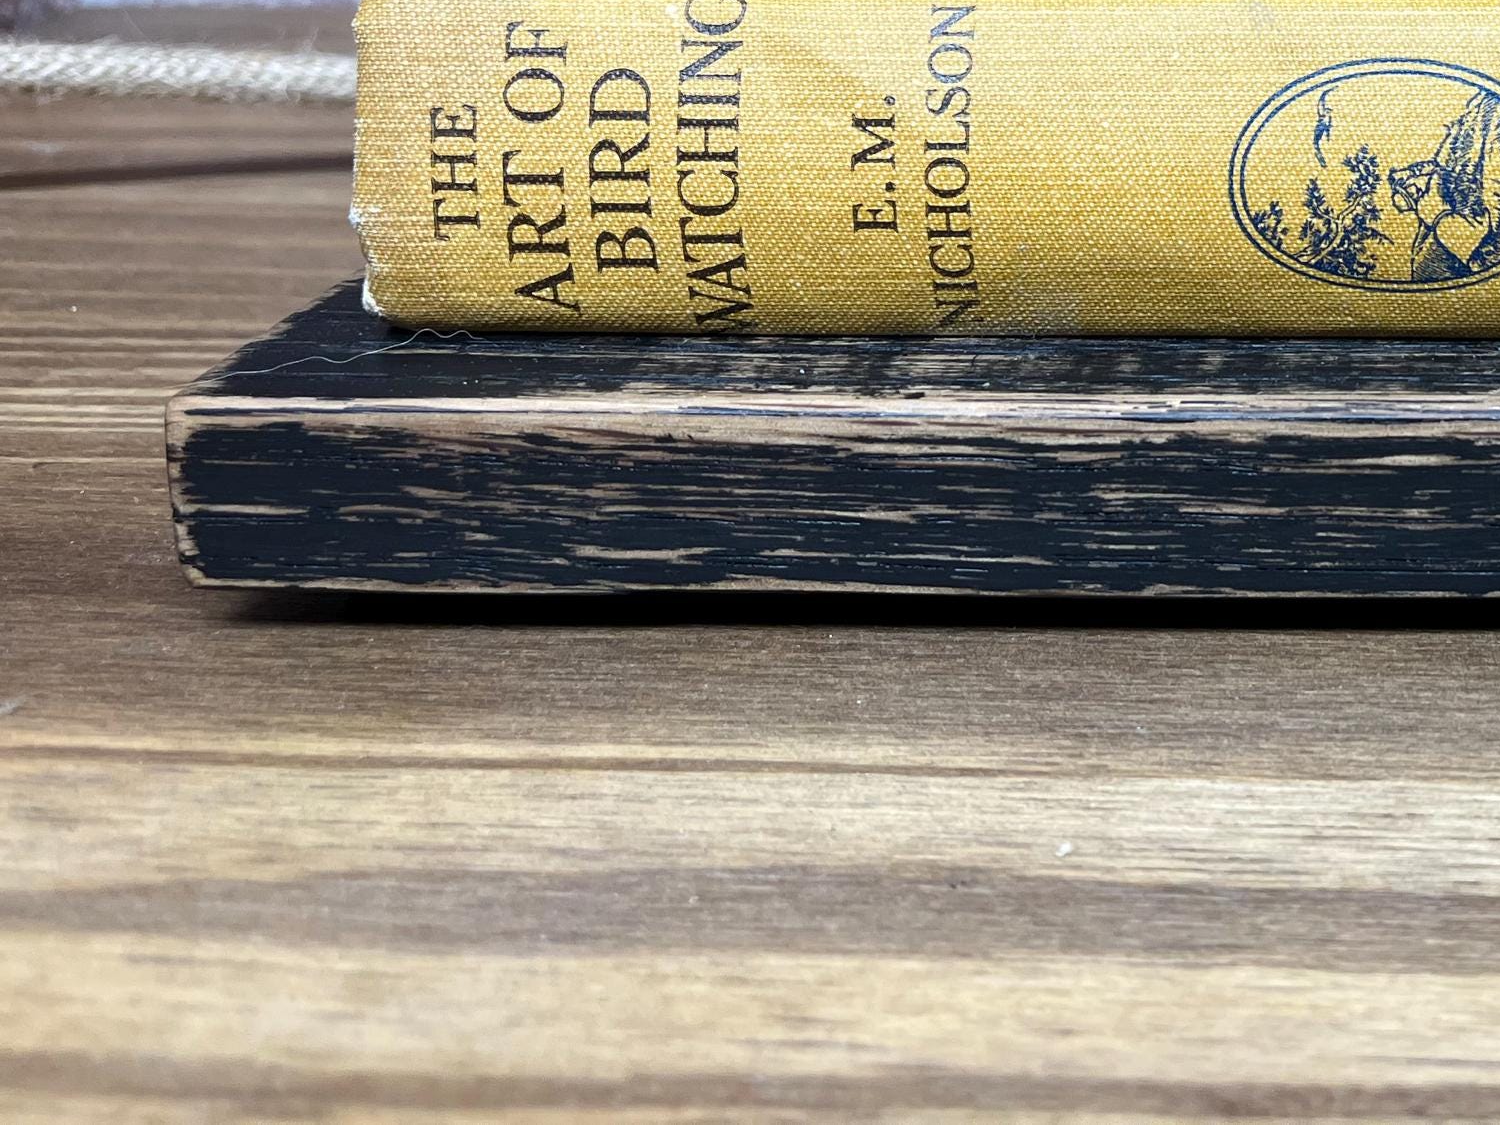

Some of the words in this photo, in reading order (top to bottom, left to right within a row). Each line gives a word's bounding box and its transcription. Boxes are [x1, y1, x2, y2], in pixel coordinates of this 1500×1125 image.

[502, 21, 568, 123] OF
[430, 103, 480, 241] THE
[502, 149, 582, 313] ART
[588, 67, 660, 274] BIRD
[924, 3, 979, 329] NICHOLSON
